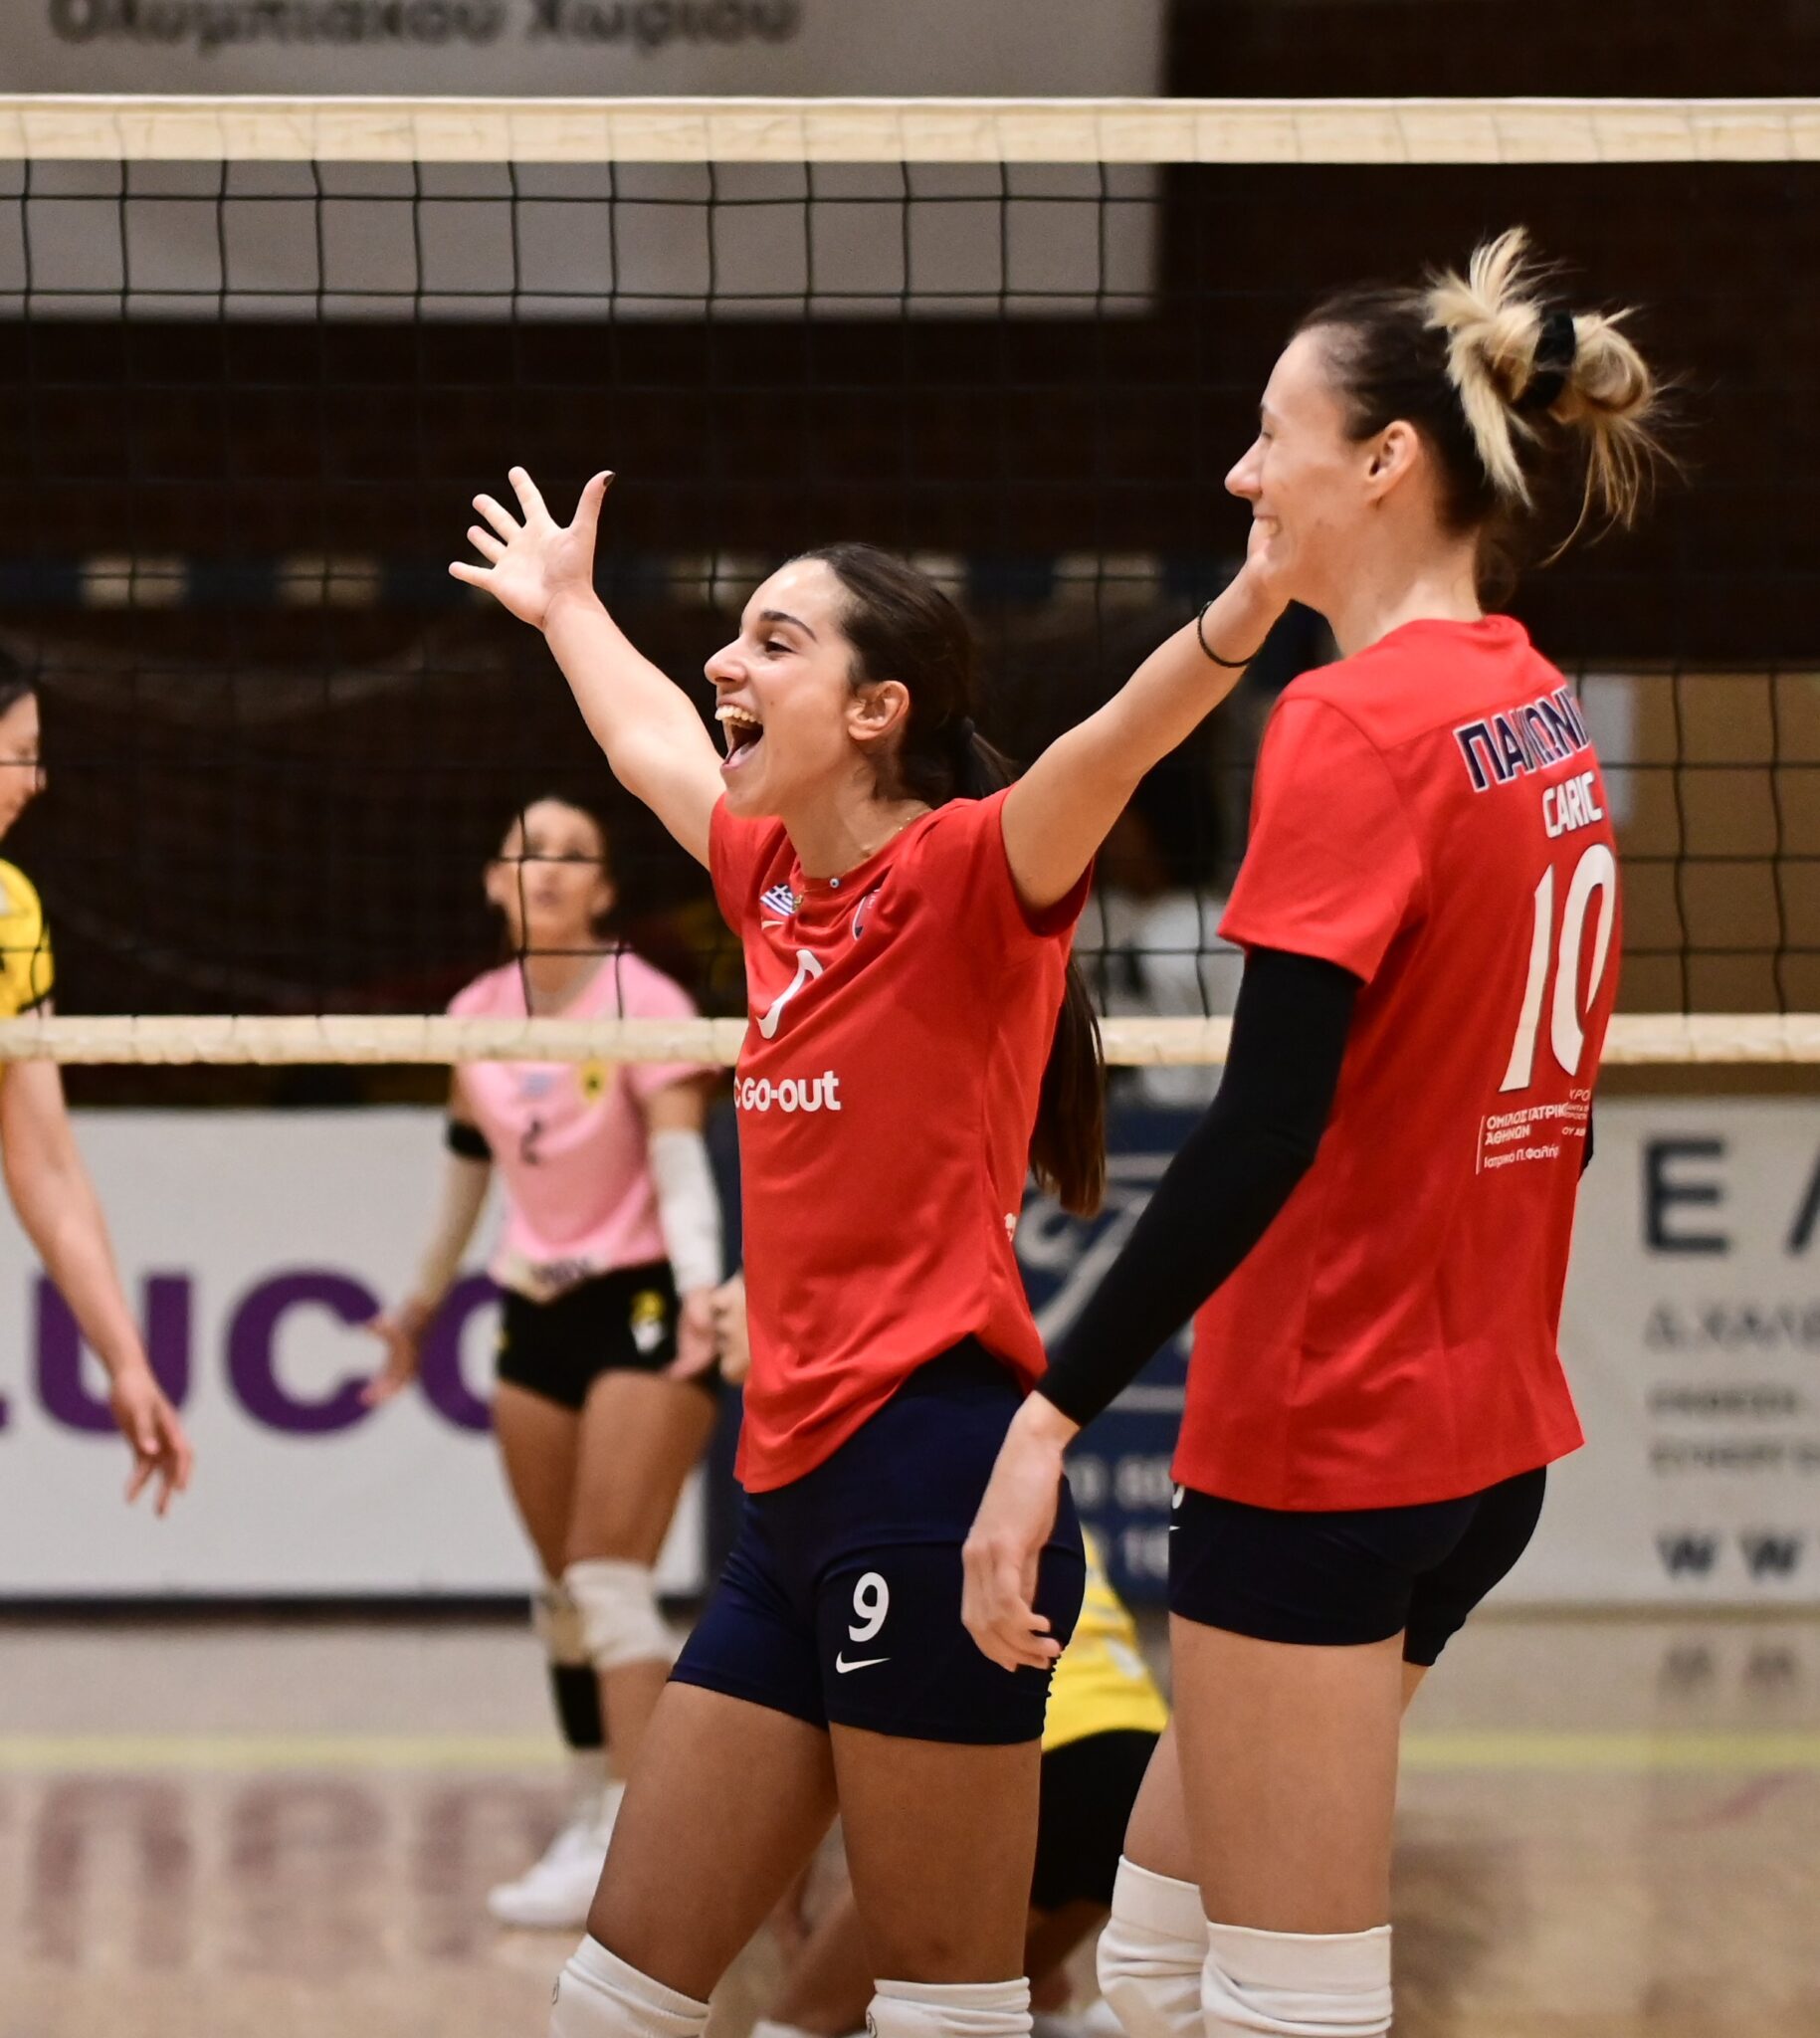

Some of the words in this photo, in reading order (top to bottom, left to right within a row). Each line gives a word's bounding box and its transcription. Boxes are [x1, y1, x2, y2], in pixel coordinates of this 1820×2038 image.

[1542, 771, 1603, 839] CARIC
[1499, 843, 1616, 1093] 10
[847, 1570, 891, 1643] 9
